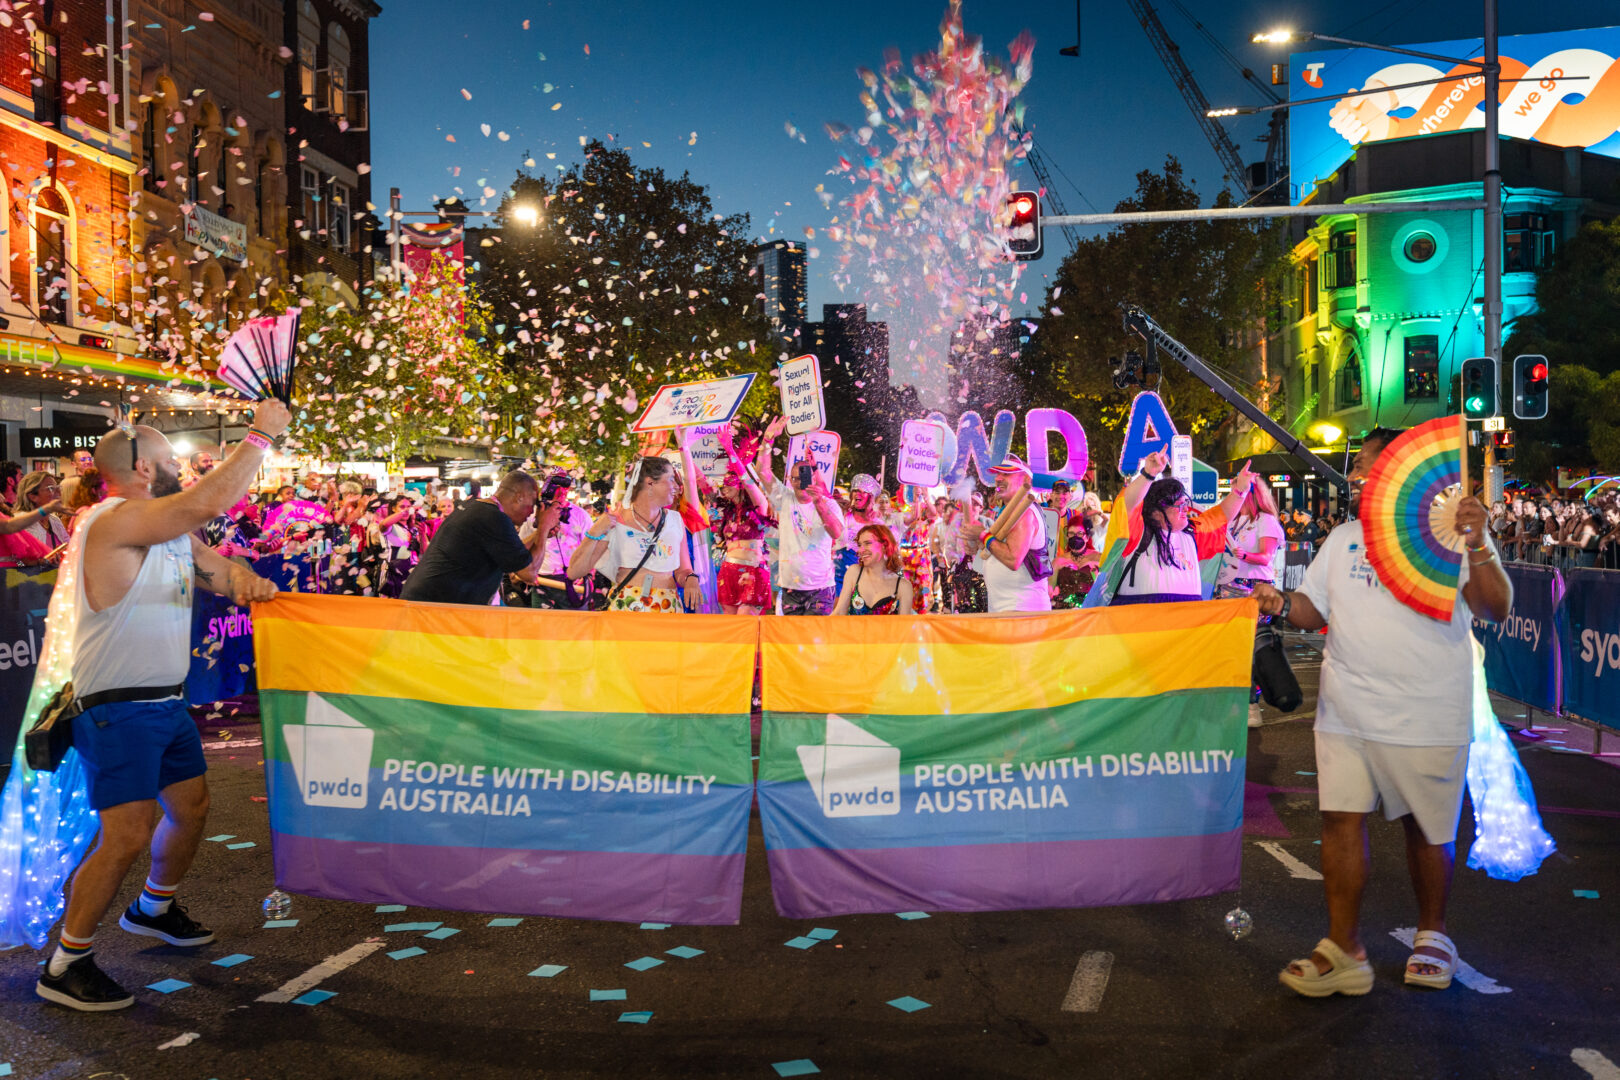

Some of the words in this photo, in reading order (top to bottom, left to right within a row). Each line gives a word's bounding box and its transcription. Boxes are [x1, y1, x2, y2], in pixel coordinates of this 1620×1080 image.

[1514, 91, 1542, 117] we
[1540, 67, 1564, 92] go
[1418, 74, 1487, 135] whereve
[788, 381, 811, 396] Rights
[789, 400, 801, 410] For
[803, 395, 813, 406] All
[694, 426, 719, 434] Abou
[790, 411, 816, 425] Bodies
[34, 436, 61, 448] BAR
[809, 440, 832, 453] Get
[914, 433, 932, 444] Our
[793, 455, 831, 474] Hny
[208, 606, 253, 649] sydne
[1493, 607, 1542, 652] ydney
[382, 758, 485, 788] PEOPLE
[493, 765, 564, 791] WITH
[570, 770, 716, 795] DISABILITY
[914, 762, 1014, 788] PEOPLE
[1020, 755, 1094, 781] WITH
[1100, 749, 1235, 778] DISABILITY
[308, 776, 363, 799] pwda
[829, 786, 895, 811] pwda
[914, 784, 1069, 814] AUSTRALIA
[379, 787, 532, 817] AUSTRALIA
